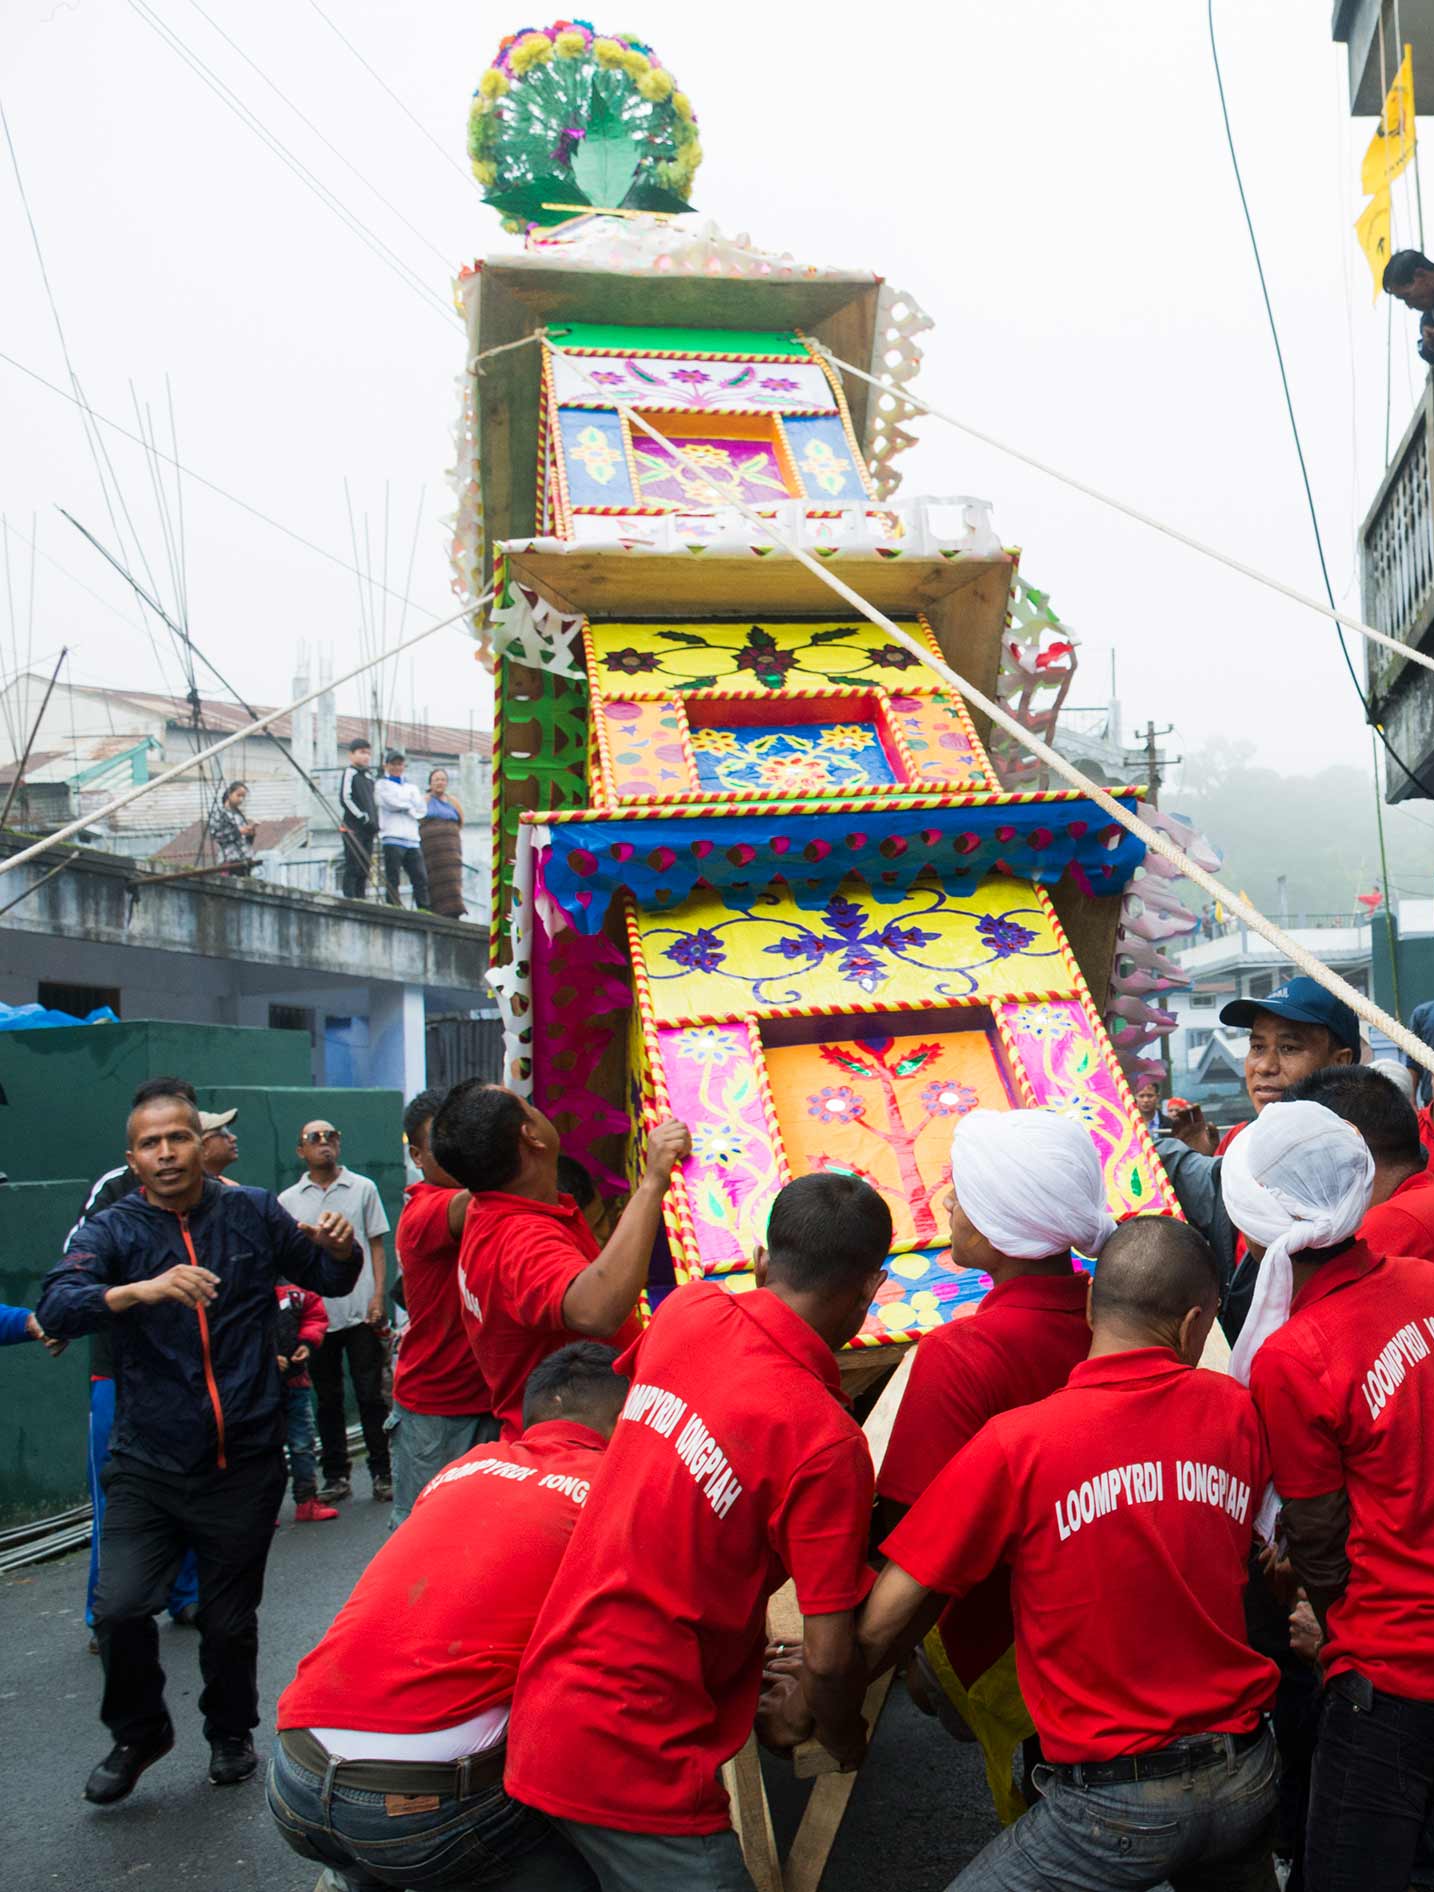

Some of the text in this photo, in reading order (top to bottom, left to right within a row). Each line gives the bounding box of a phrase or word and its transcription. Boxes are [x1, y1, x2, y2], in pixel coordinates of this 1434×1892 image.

[1361, 1320, 1431, 1421] LOOMPYRDI
[538, 1473, 591, 1509] IONG
[675, 1412, 743, 1520] IONGPIAH
[1055, 1460, 1250, 1542] LOOMPYRDI IONGPIAH
